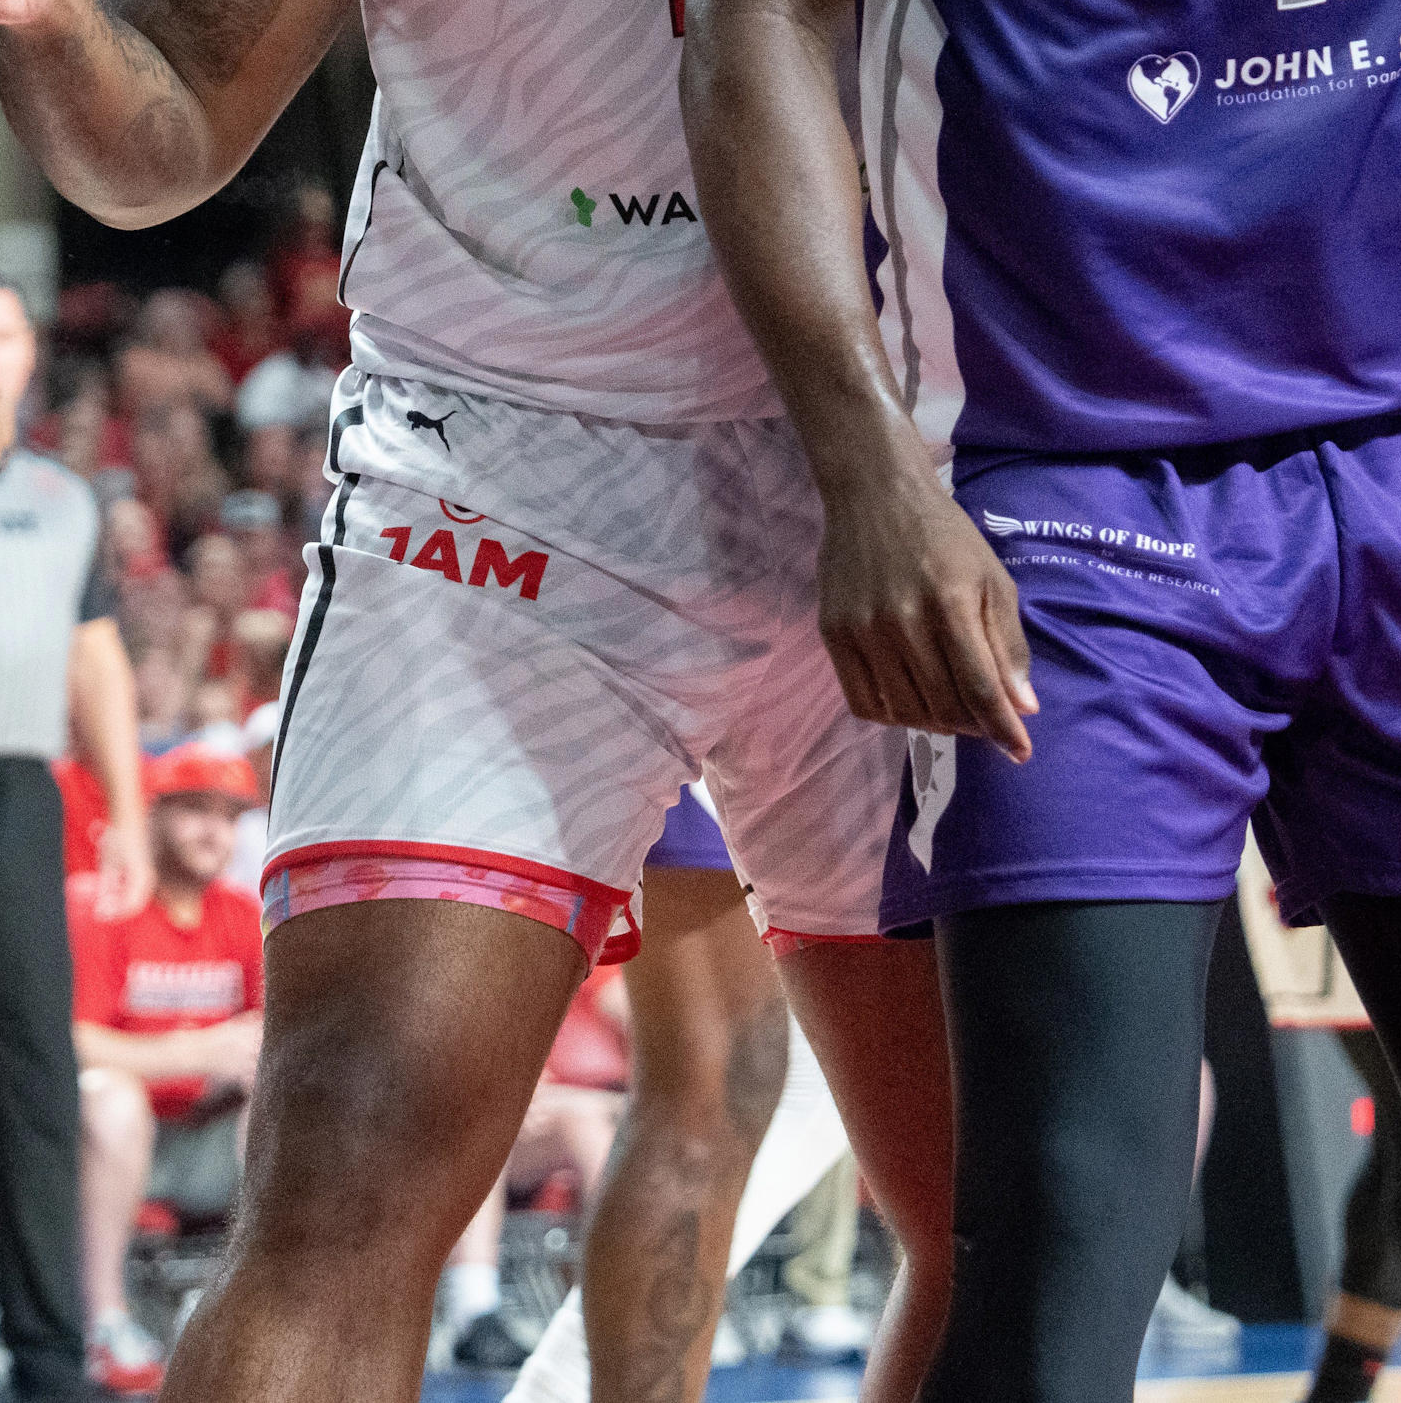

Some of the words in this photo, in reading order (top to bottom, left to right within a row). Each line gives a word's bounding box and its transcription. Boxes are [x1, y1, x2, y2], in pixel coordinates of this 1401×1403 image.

[1214, 44, 1334, 90] JOHN
[1348, 38, 1387, 71] E.
[1216, 82, 1322, 107] foundation
[1329, 78, 1355, 93] for
[1022, 519, 1093, 541] WINGS
[1099, 526, 1131, 547] OF
[1135, 532, 1197, 560] HOPE
[378, 525, 550, 602] JAM
[1087, 559, 1144, 581] CANCER
[1147, 572, 1221, 598] RESEARCH
